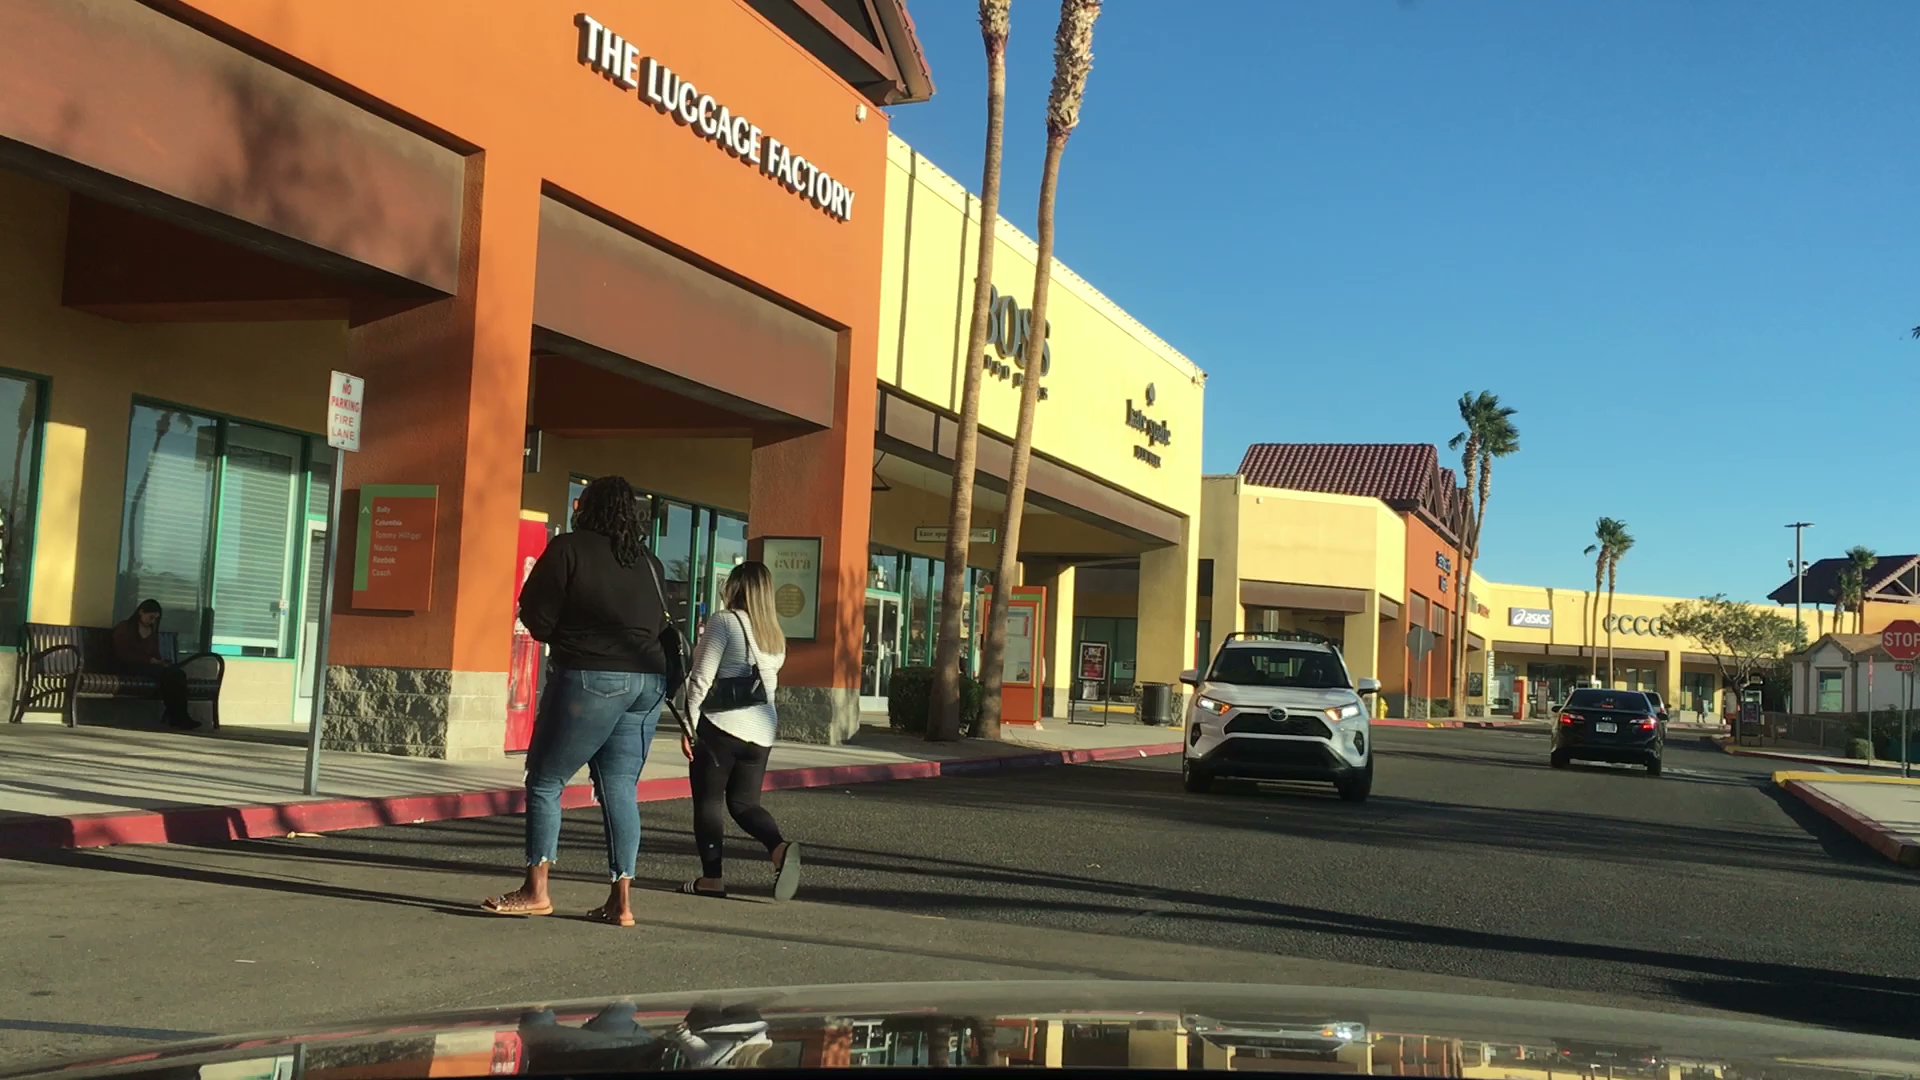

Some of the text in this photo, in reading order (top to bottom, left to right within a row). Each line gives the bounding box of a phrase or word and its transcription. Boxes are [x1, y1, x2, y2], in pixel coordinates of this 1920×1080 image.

[575, 13, 855, 223] THE LUGGAGE FACTORY
[342, 384, 352, 395] NO
[331, 396, 360, 413] PARKING
[335, 413, 354, 427] FIRE
[332, 427, 355, 441] LANE
[375, 531, 397, 540] Tommy
[373, 556, 396, 564] Reebok
[774, 558, 812, 570] extra
[372, 569, 391, 577] Coach
[1525, 612, 1551, 625] asics
[1884, 631, 1920, 648] STOP
